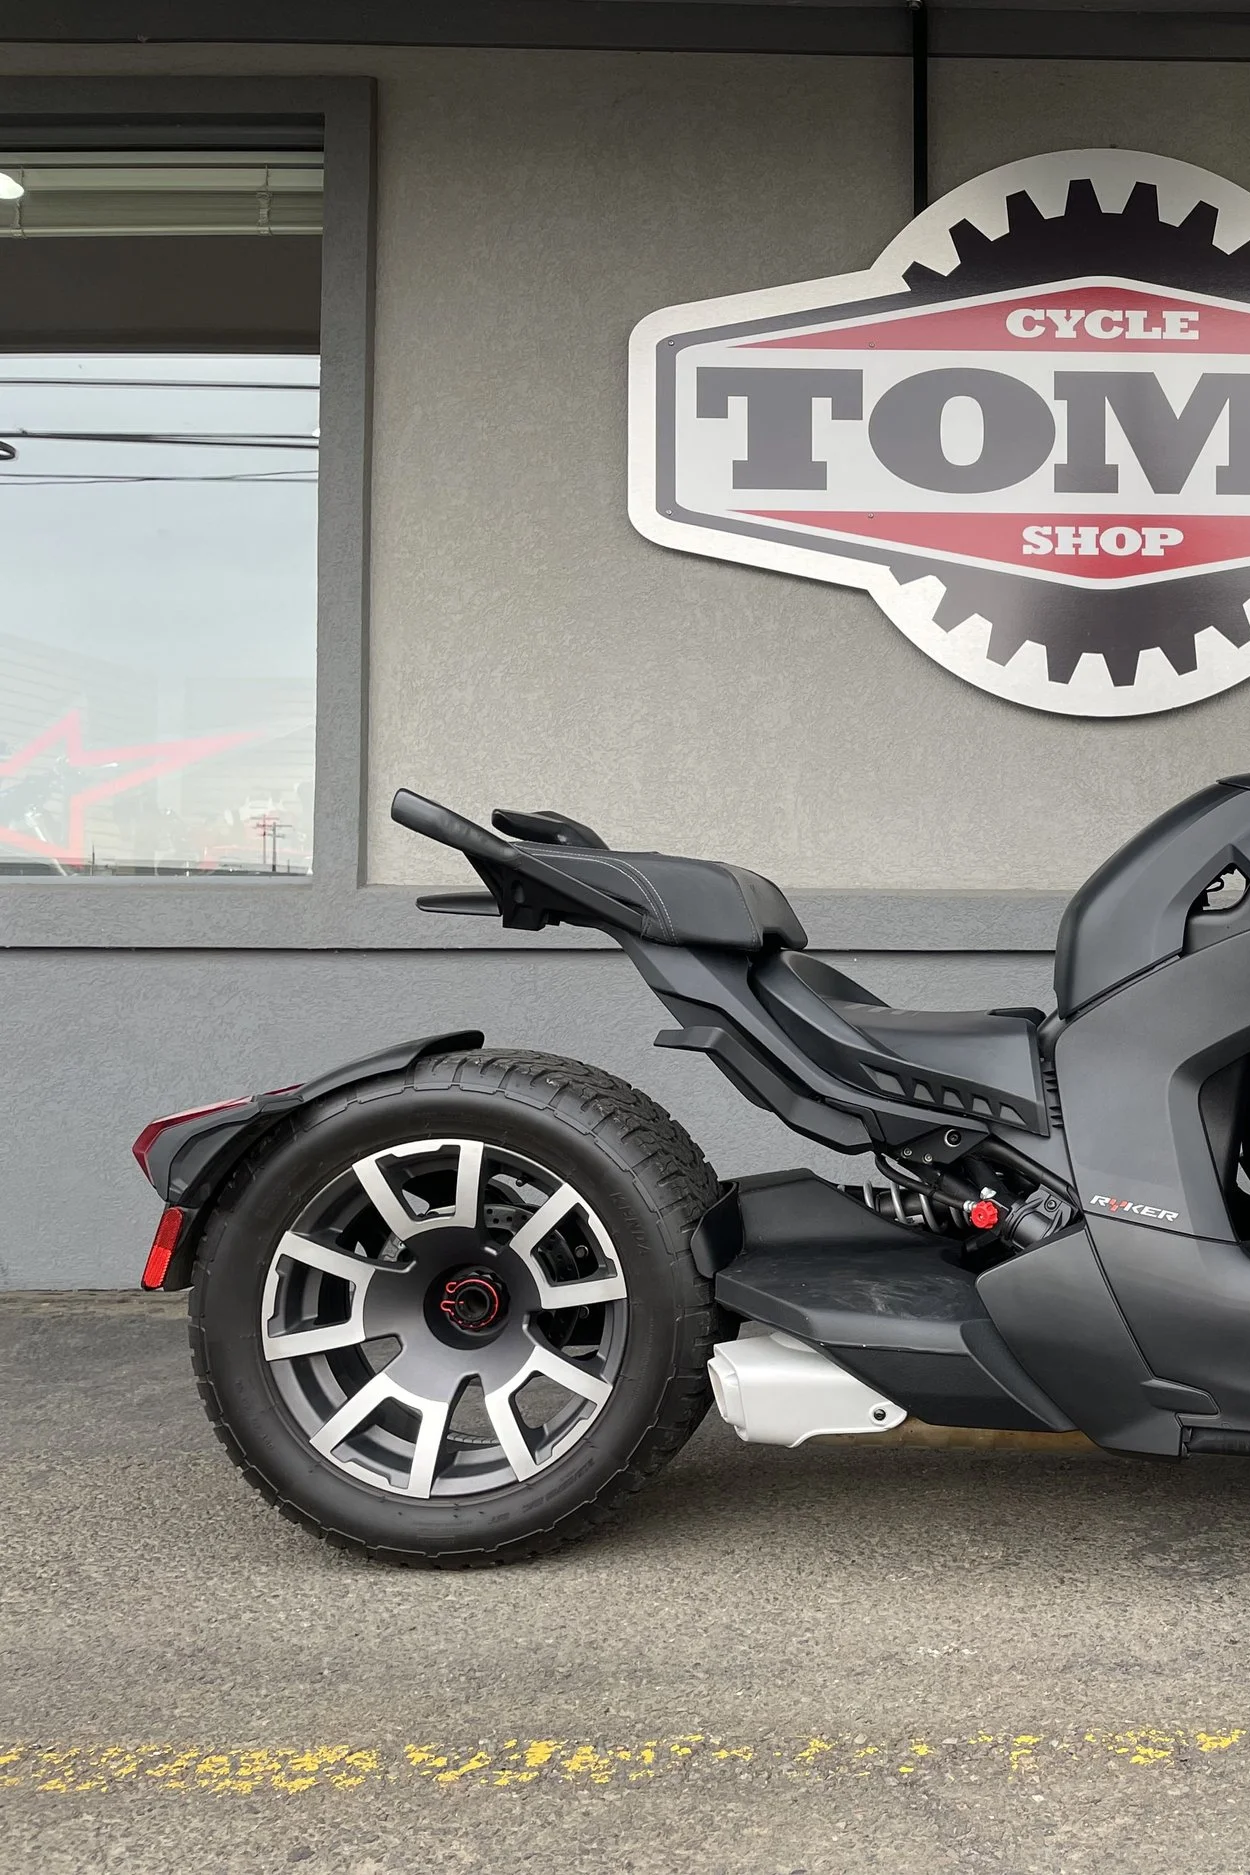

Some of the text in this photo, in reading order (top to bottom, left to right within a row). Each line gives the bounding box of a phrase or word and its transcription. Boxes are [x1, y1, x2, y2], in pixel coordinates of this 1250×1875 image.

[1005, 309, 1200, 341] CYCLE
[1022, 525, 1184, 556] SHOP
[1090, 1194, 1179, 1222] RYKER
